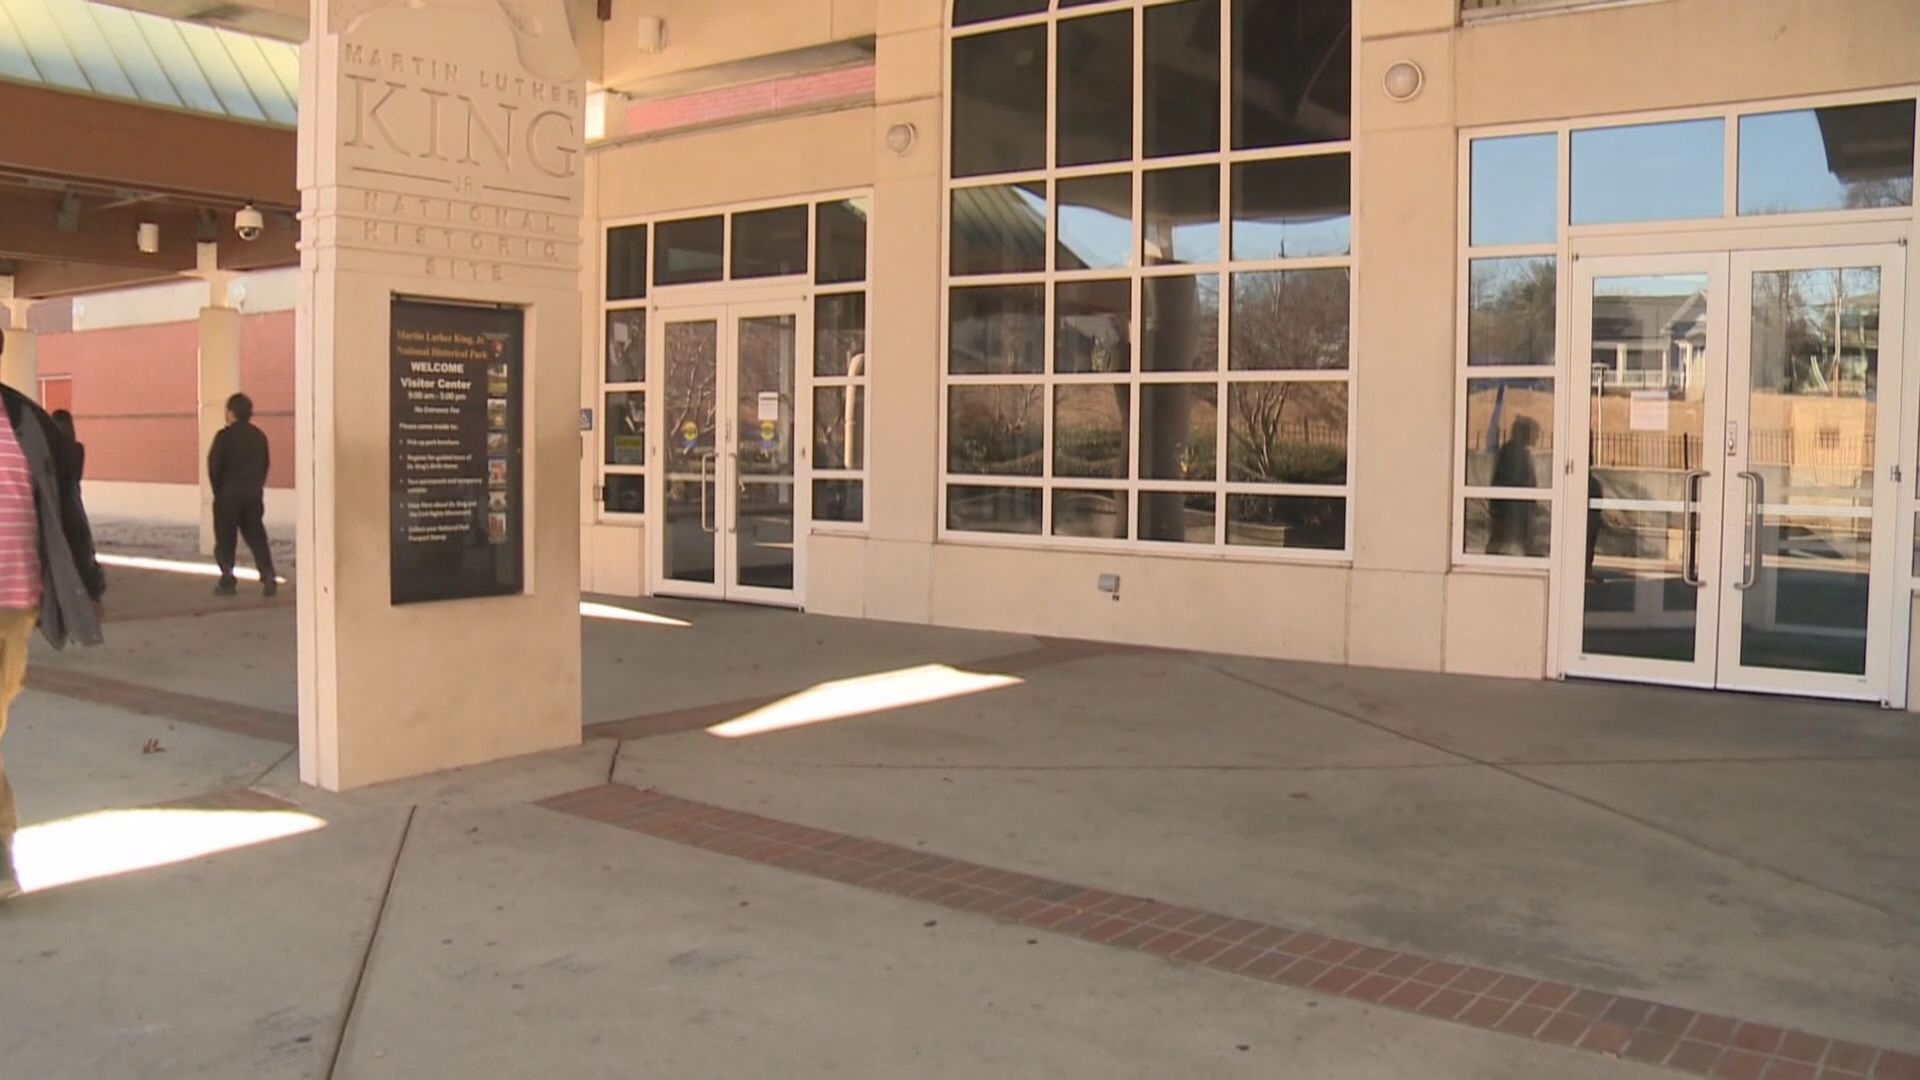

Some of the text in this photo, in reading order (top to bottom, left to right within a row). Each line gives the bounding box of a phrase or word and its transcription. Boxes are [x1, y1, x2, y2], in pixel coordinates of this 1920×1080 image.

[345, 43, 578, 108] MARTIN LUTHER
[344, 73, 578, 178] KING
[453, 175, 472, 193] JR
[364, 191, 556, 232] NATIONAL
[364, 220, 559, 262] HISTORIC
[425, 257, 503, 281] SITE
[397, 330, 424, 340] Martin
[426, 332, 452, 342] Luther
[397, 346, 488, 359] National Historical Park
[411, 361, 464, 374] WELCOME
[400, 377, 472, 390] Visitor Center
[408, 391, 423, 400] 9:00
[440, 391, 454, 401] 5:00
[455, 393, 467, 402] pm
[424, 406, 449, 414] Entrance
[450, 406, 460, 414] Fee
